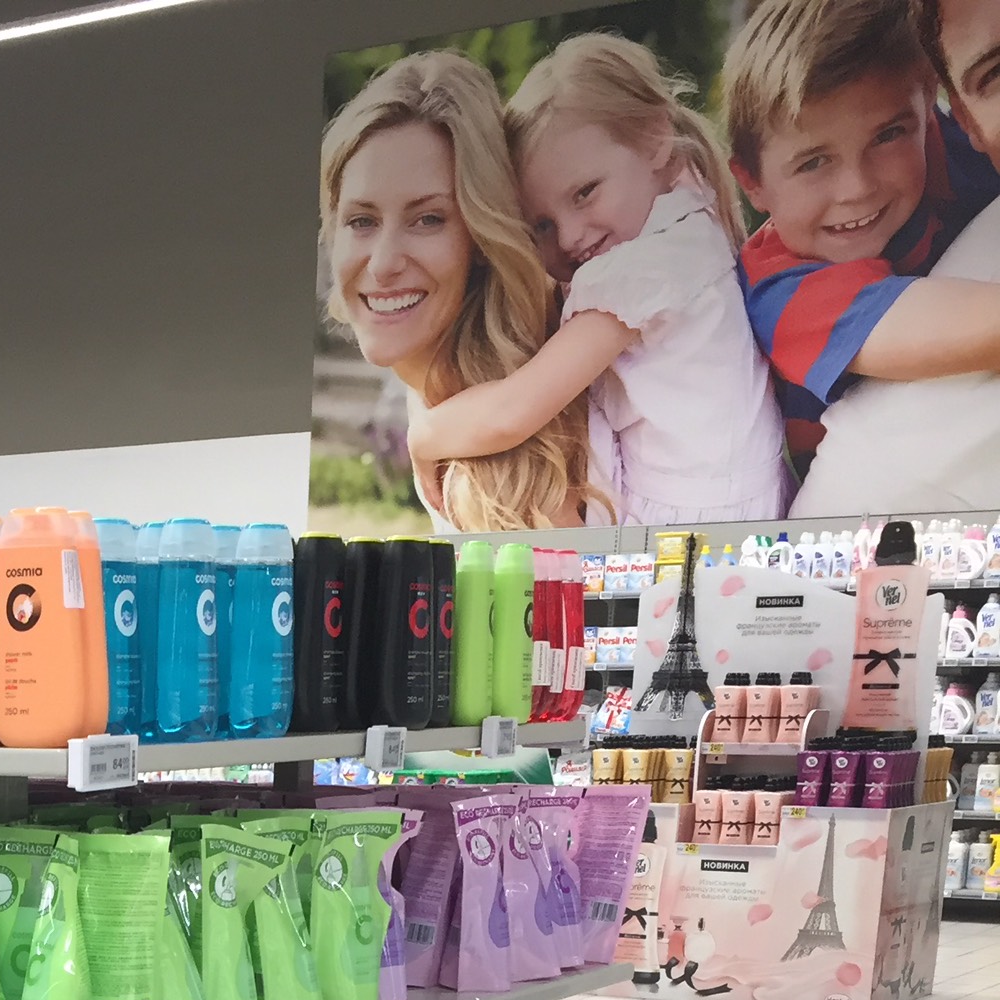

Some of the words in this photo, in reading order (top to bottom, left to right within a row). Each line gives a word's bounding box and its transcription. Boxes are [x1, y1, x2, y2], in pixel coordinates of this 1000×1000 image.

[5, 567, 43, 578] cosmia
[606, 564, 627, 573] Persil
[631, 563, 653, 573] Persil
[882, 585, 899, 598] Ver
[759, 597, 801, 606] НОВИНКА
[885, 592, 900, 606] nel
[863, 617, 912, 629] Suprême
[598, 636, 620, 645] Persil
[254, 850, 268, 861] 250
[703, 862, 746, 871] НОВИНКА
